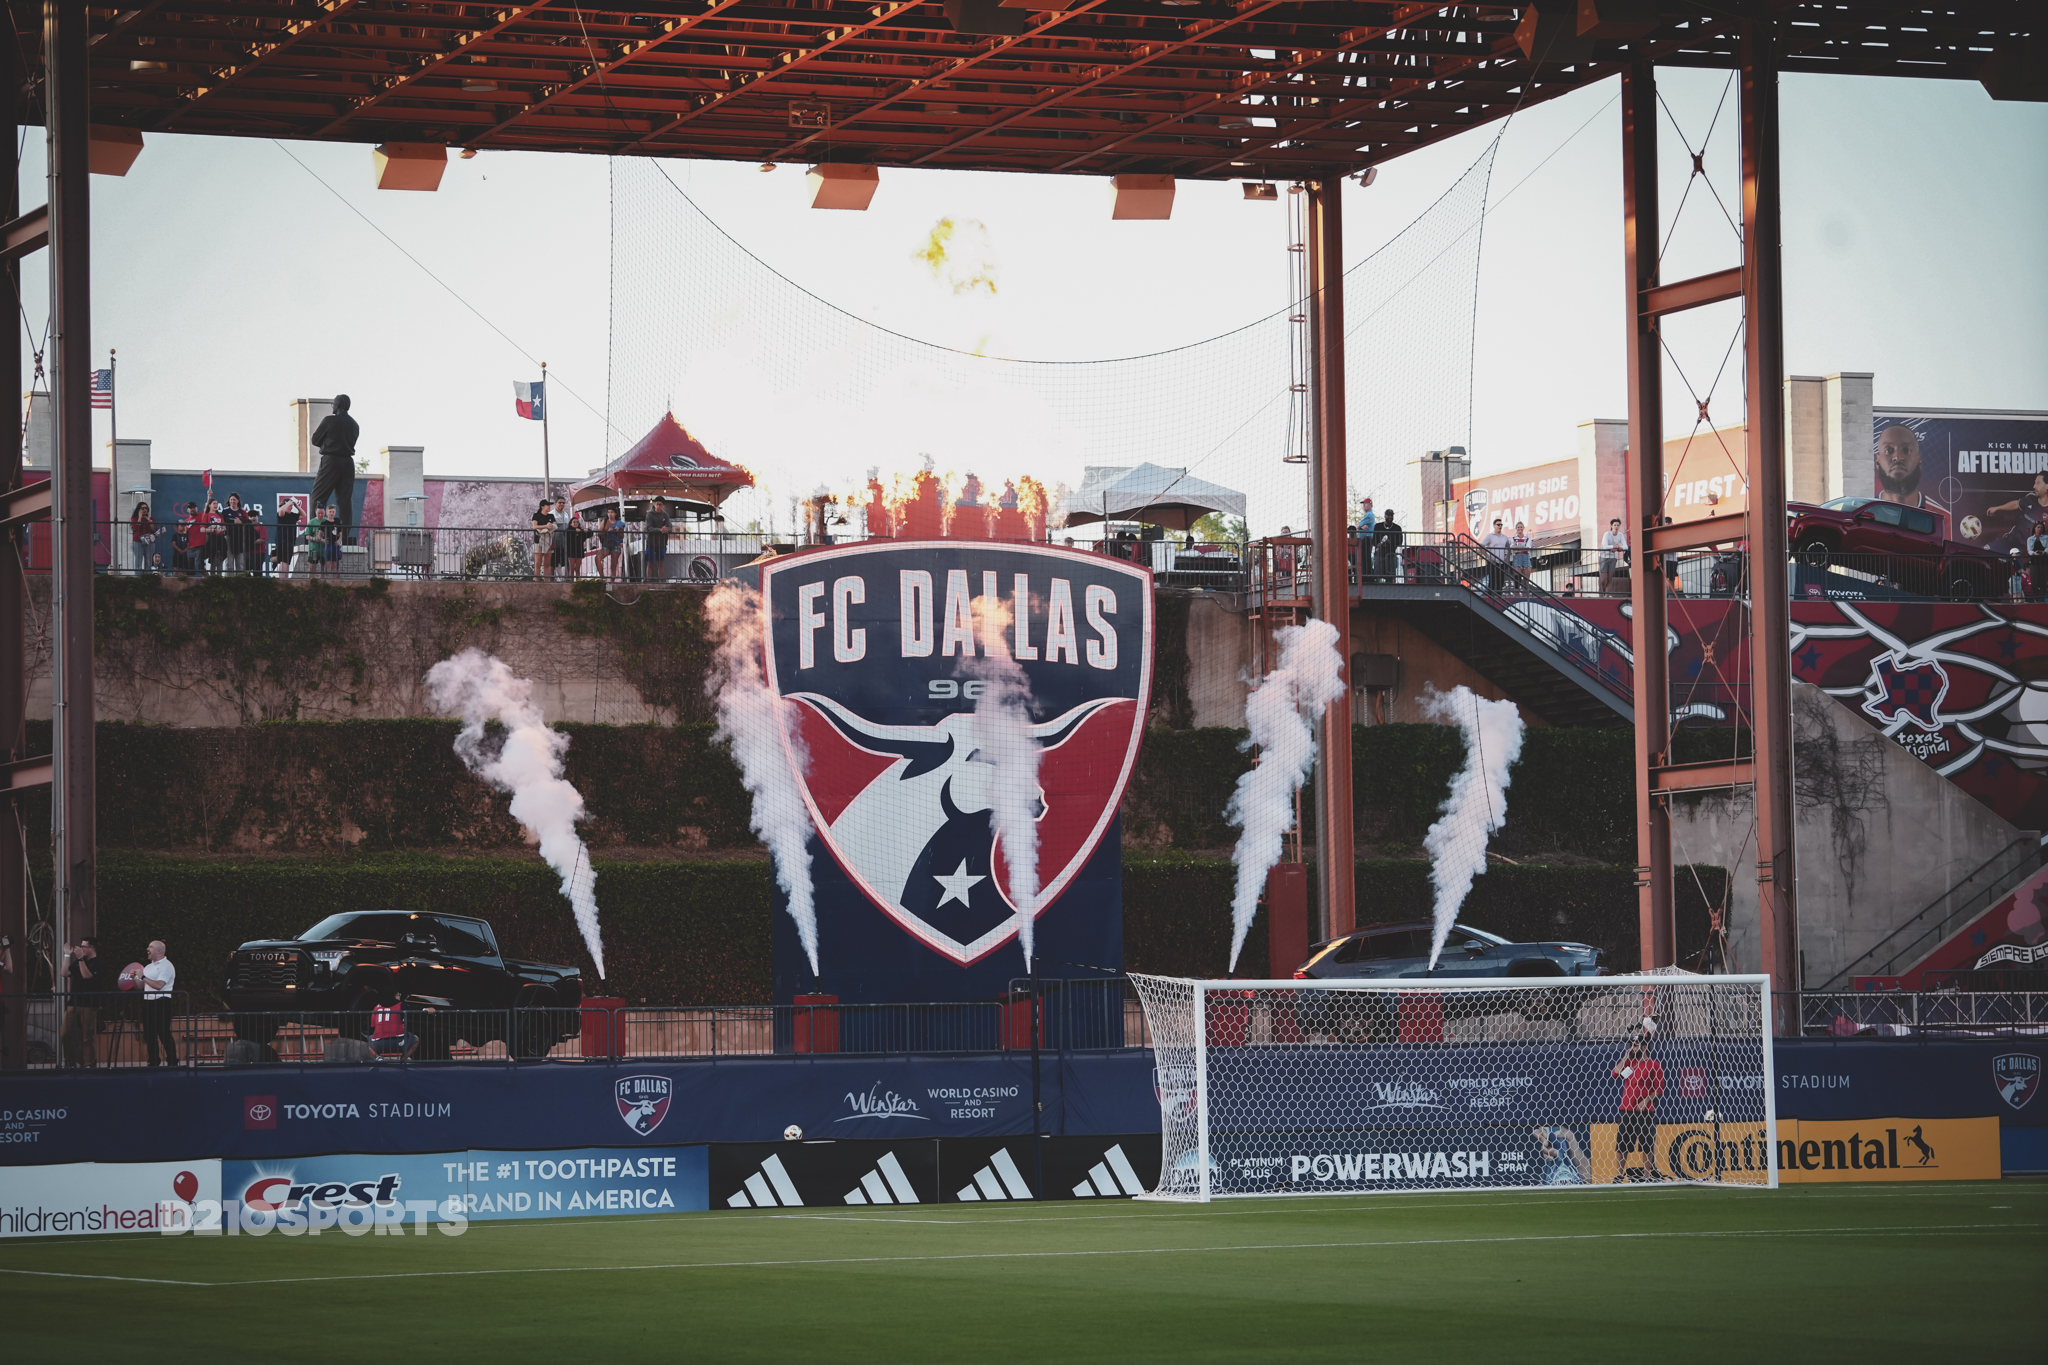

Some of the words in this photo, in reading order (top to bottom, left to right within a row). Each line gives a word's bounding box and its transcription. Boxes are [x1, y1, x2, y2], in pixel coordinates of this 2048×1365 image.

[1492, 482, 1535, 504] NORTH
[1538, 475, 1568, 495] SIDE
[1674, 473, 1736, 508] FIRST
[1489, 504, 1530, 534] FAN
[1535, 495, 1581, 525] SHO
[1825, 589, 1867, 600] TOYOTA
[798, 575, 866, 670] FC
[899, 569, 1118, 670] DALLAS
[1897, 731, 1943, 744] texas
[1904, 740, 1950, 760] riginal
[250, 953, 286, 961] TOYOTA
[1980, 946, 2030, 967] SIEMPRE
[1997, 1058, 2006, 1072] FC
[2009, 1057, 2037, 1071] DALLAS
[620, 1081, 631, 1096] FC
[634, 1079, 668, 1094] DALLAS
[1449, 1077, 1489, 1089] WORLD
[1491, 1075, 1533, 1087] CASINO
[1781, 1075, 1850, 1089] STADIUM
[927, 1088, 971, 1099] WORLD
[973, 1086, 1019, 1098] CASINO
[842, 1083, 921, 1119] WinStar
[964, 1099, 982, 1107] AND
[1470, 1097, 1512, 1108] RESORT
[16, 1108, 67, 1121] CASINO
[283, 1103, 361, 1120] TOYOTA
[368, 1102, 451, 1118] STADIUM
[950, 1107, 996, 1119] RESORT
[5, 1122, 25, 1130] AND
[1501, 1152, 1524, 1162] DISH
[1668, 1128, 1901, 1182] Continental
[1230, 1157, 1284, 1168] PLATINUM
[1291, 1150, 1490, 1182] POWERWASH
[1498, 1162, 1529, 1173] SPRAY
[443, 1161, 490, 1183] THE
[496, 1160, 520, 1181] #1
[525, 1157, 677, 1180] TOOTHPASTE
[1243, 1168, 1271, 1179] PLUS
[243, 1172, 401, 1212] Crest
[448, 1192, 532, 1214] BRAND
[538, 1191, 562, 1211] IN
[567, 1188, 675, 1211] AMERICA
